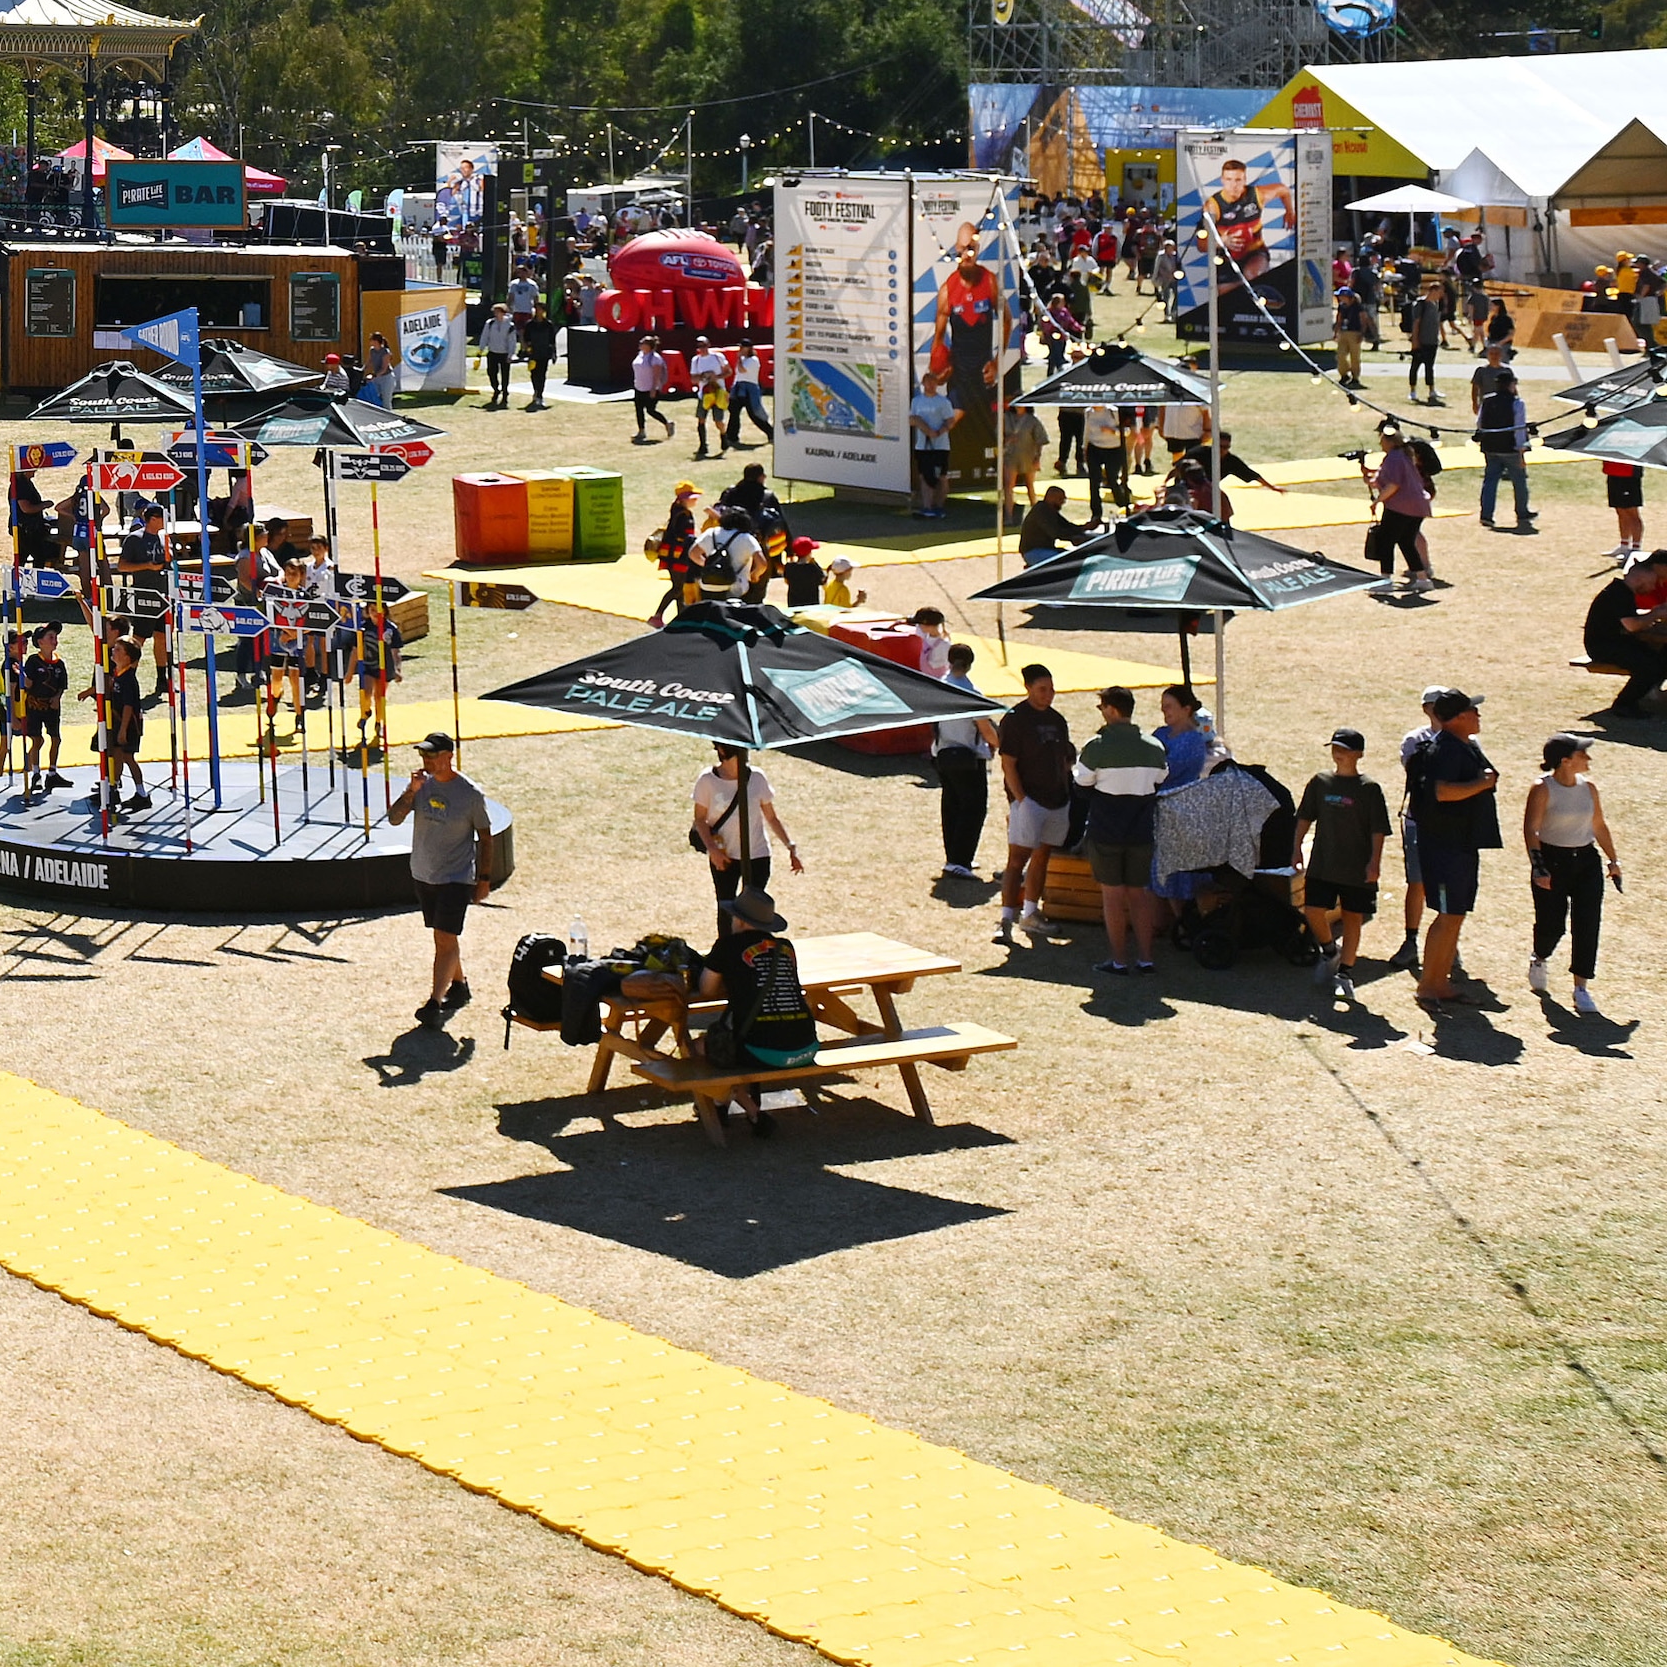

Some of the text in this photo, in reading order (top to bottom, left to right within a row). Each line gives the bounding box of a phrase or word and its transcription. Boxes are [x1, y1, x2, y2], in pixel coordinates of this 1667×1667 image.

[175, 185, 235, 204] BAR
[804, 201, 876, 219] FOOTY FESTIVAL
[663, 254, 689, 265] AFL
[594, 289, 674, 332] OH
[403, 314, 442, 334] ADELAIDE
[69, 397, 113, 406] South
[577, 668, 735, 706] South Coast
[562, 683, 722, 722] PALE ALE
[34, 856, 109, 891] ADELAIDE
